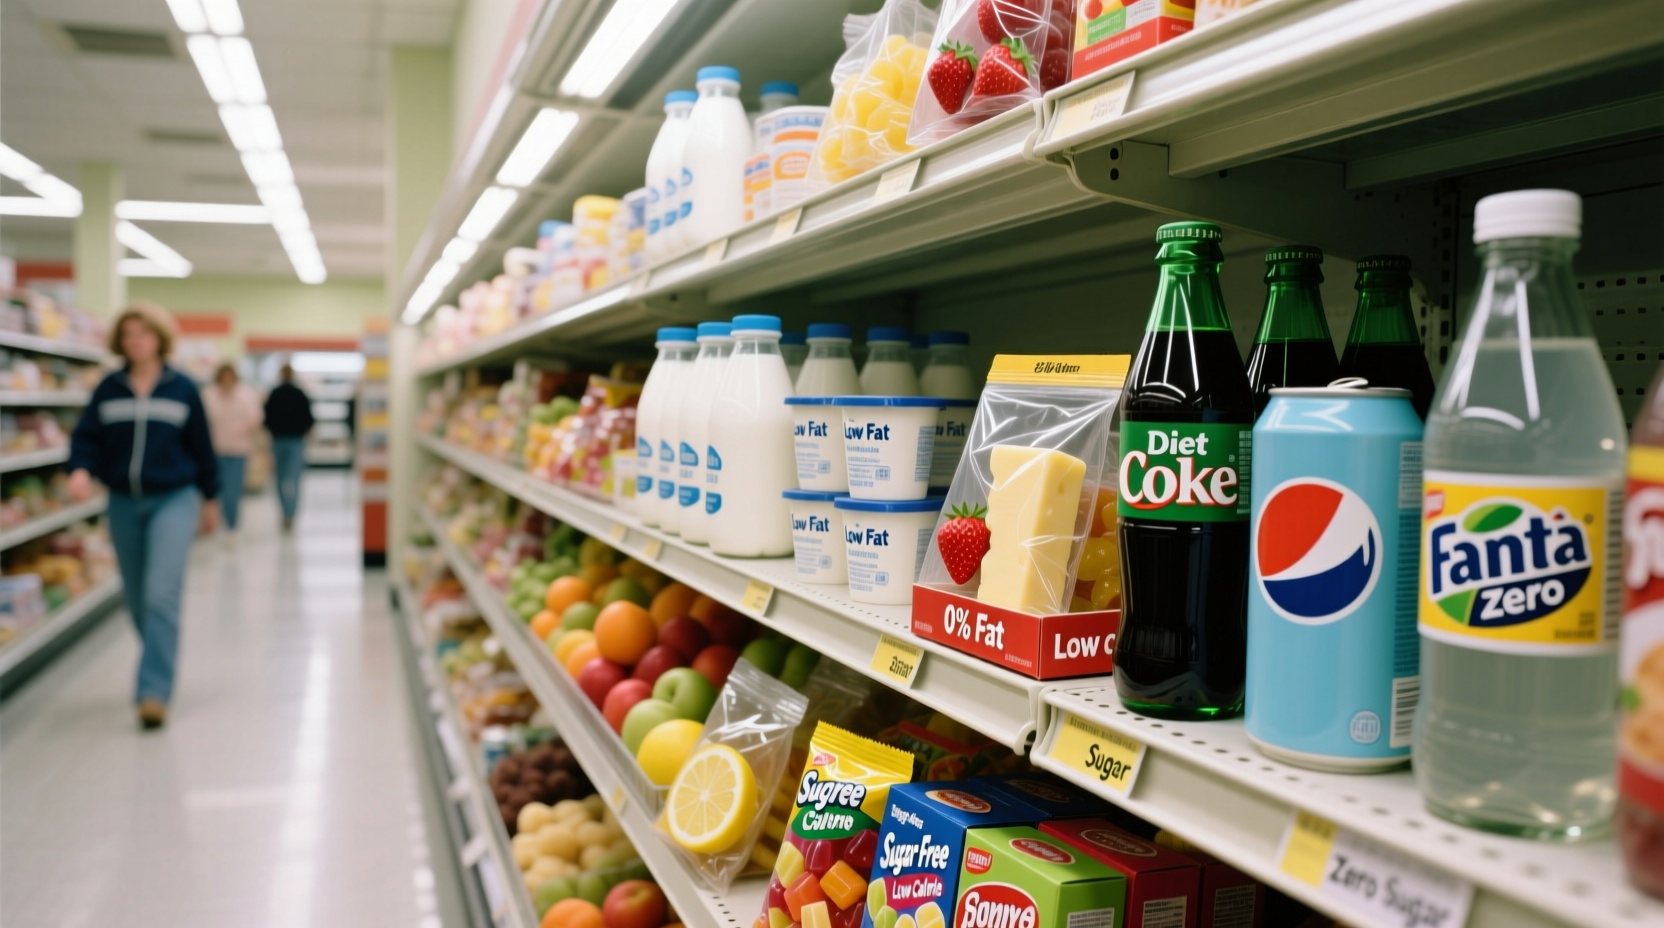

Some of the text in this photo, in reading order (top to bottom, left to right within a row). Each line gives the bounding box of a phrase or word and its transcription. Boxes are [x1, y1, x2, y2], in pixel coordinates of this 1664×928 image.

[808, 420, 828, 438] Fat
[844, 422, 890, 441] Low Fat
[946, 420, 966, 437] Fat
[1147, 430, 1209, 456] Diet
[1119, 450, 1238, 510] Coke
[809, 516, 830, 532] Fat
[866, 528, 889, 546] Fat
[1431, 517, 1588, 596] Fanta
[1480, 579, 1565, 621] zero
[943, 603, 1005, 650] 0% Fat
[1054, 633, 1101, 660] Low
[1084, 744, 1131, 781] Sugar
[797, 769, 866, 811] Sugree
[917, 834, 950, 870] Free
[1328, 854, 1378, 899] Zero
